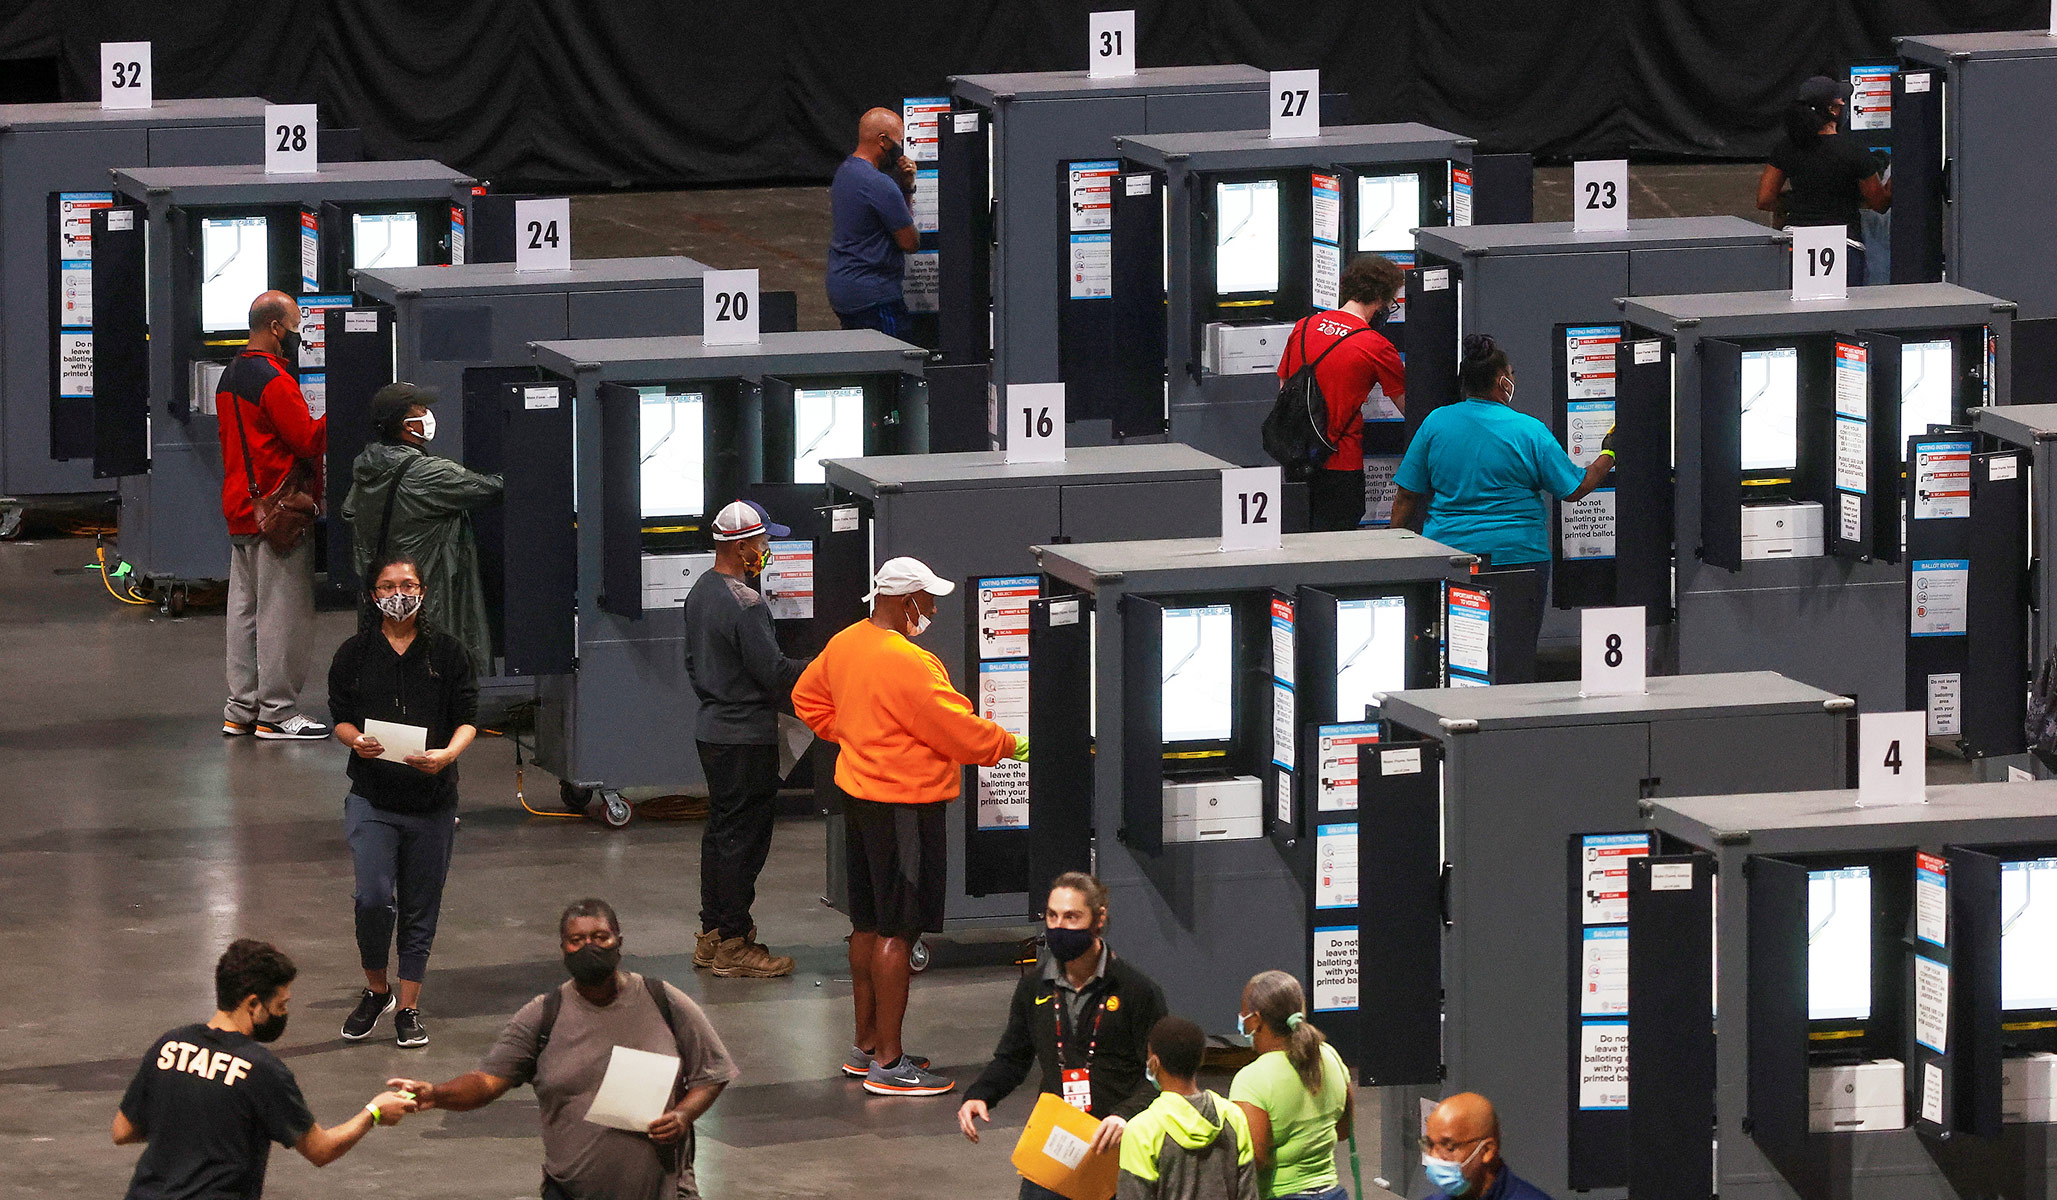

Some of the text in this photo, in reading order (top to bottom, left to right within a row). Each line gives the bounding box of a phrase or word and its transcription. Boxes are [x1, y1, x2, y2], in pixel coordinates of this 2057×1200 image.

[1099, 30, 1122, 57] 31
[111, 61, 141, 89] 32
[1280, 89, 1310, 117] 27
[276, 124, 307, 152] 28
[1585, 181, 1617, 210] 23
[527, 220, 560, 249] 24
[1807, 247, 1835, 277] 19
[715, 291, 749, 322] 20
[1316, 323, 1348, 337] 2016
[1023, 406, 1053, 438] 16
[1238, 491, 1268, 525] 12
[1604, 633, 1623, 668] 8
[1883, 739, 1903, 775] 4
[981, 780, 1015, 788] balloting
[981, 798, 1009, 807] printed
[1317, 959, 1351, 967] balloting
[1317, 978, 1350, 987] printed
[156, 1040, 253, 1086] STAFF
[1585, 1055, 1622, 1064] balloting
[1584, 1075, 1615, 1083] printed
